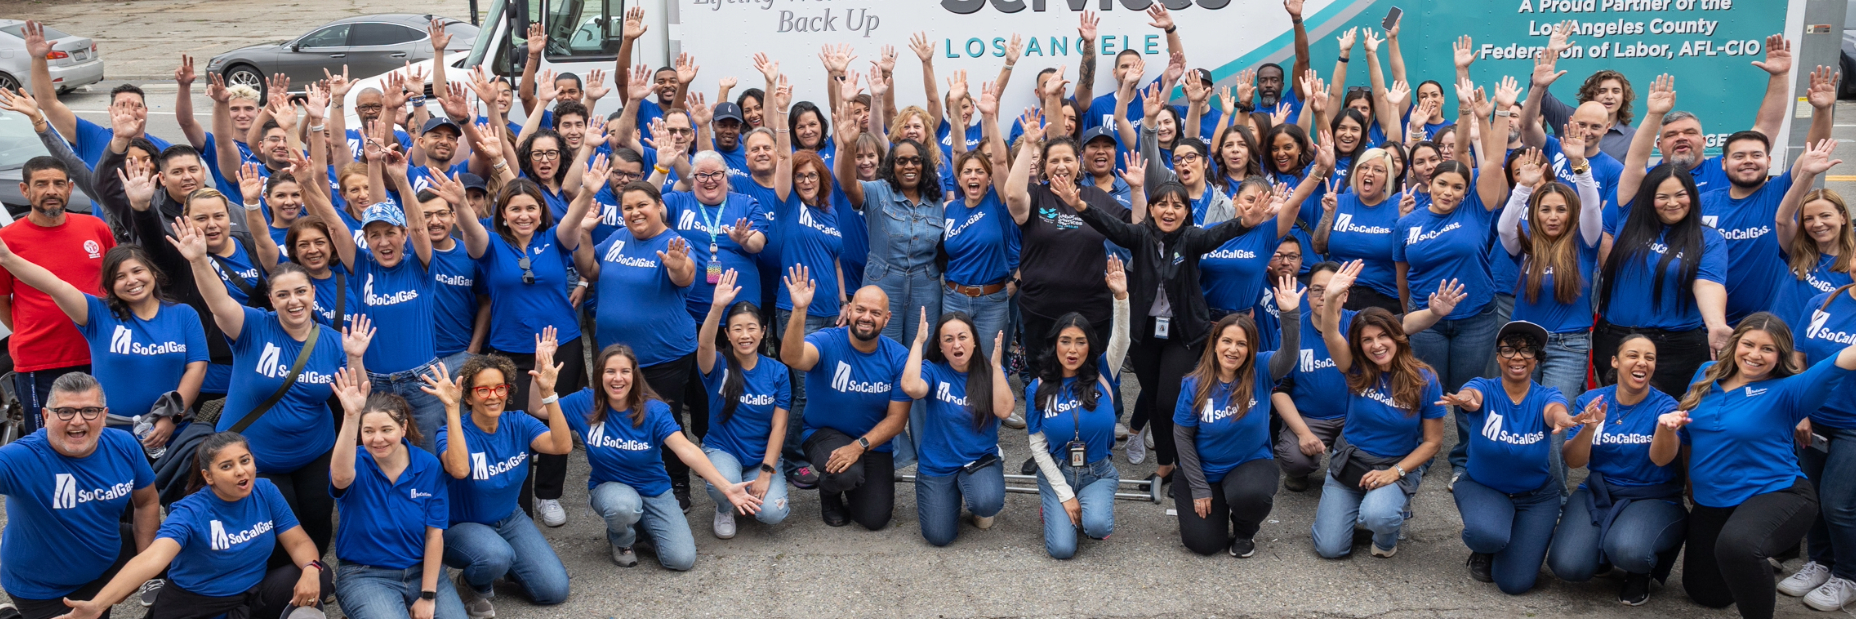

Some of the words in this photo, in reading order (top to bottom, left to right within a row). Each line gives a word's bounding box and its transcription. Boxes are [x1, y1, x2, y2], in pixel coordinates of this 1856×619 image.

[1518, 0, 1534, 13] A
[1539, 0, 1597, 13] Proud
[1601, 0, 1671, 12] Partner
[1676, 0, 1698, 11] of
[1700, 0, 1734, 11] the
[777, 8, 838, 33] Back
[846, 8, 880, 38] Up
[1569, 19, 1645, 38] Angeles
[1650, 18, 1719, 36] County
[945, 37, 1006, 58] LOS
[1481, 43, 1583, 60] Federaon
[1588, 43, 1611, 58] of
[1614, 41, 1674, 60] Labor,
[1679, 40, 1762, 57] AFL-CIO
[435, 273, 474, 287] oCalGas
